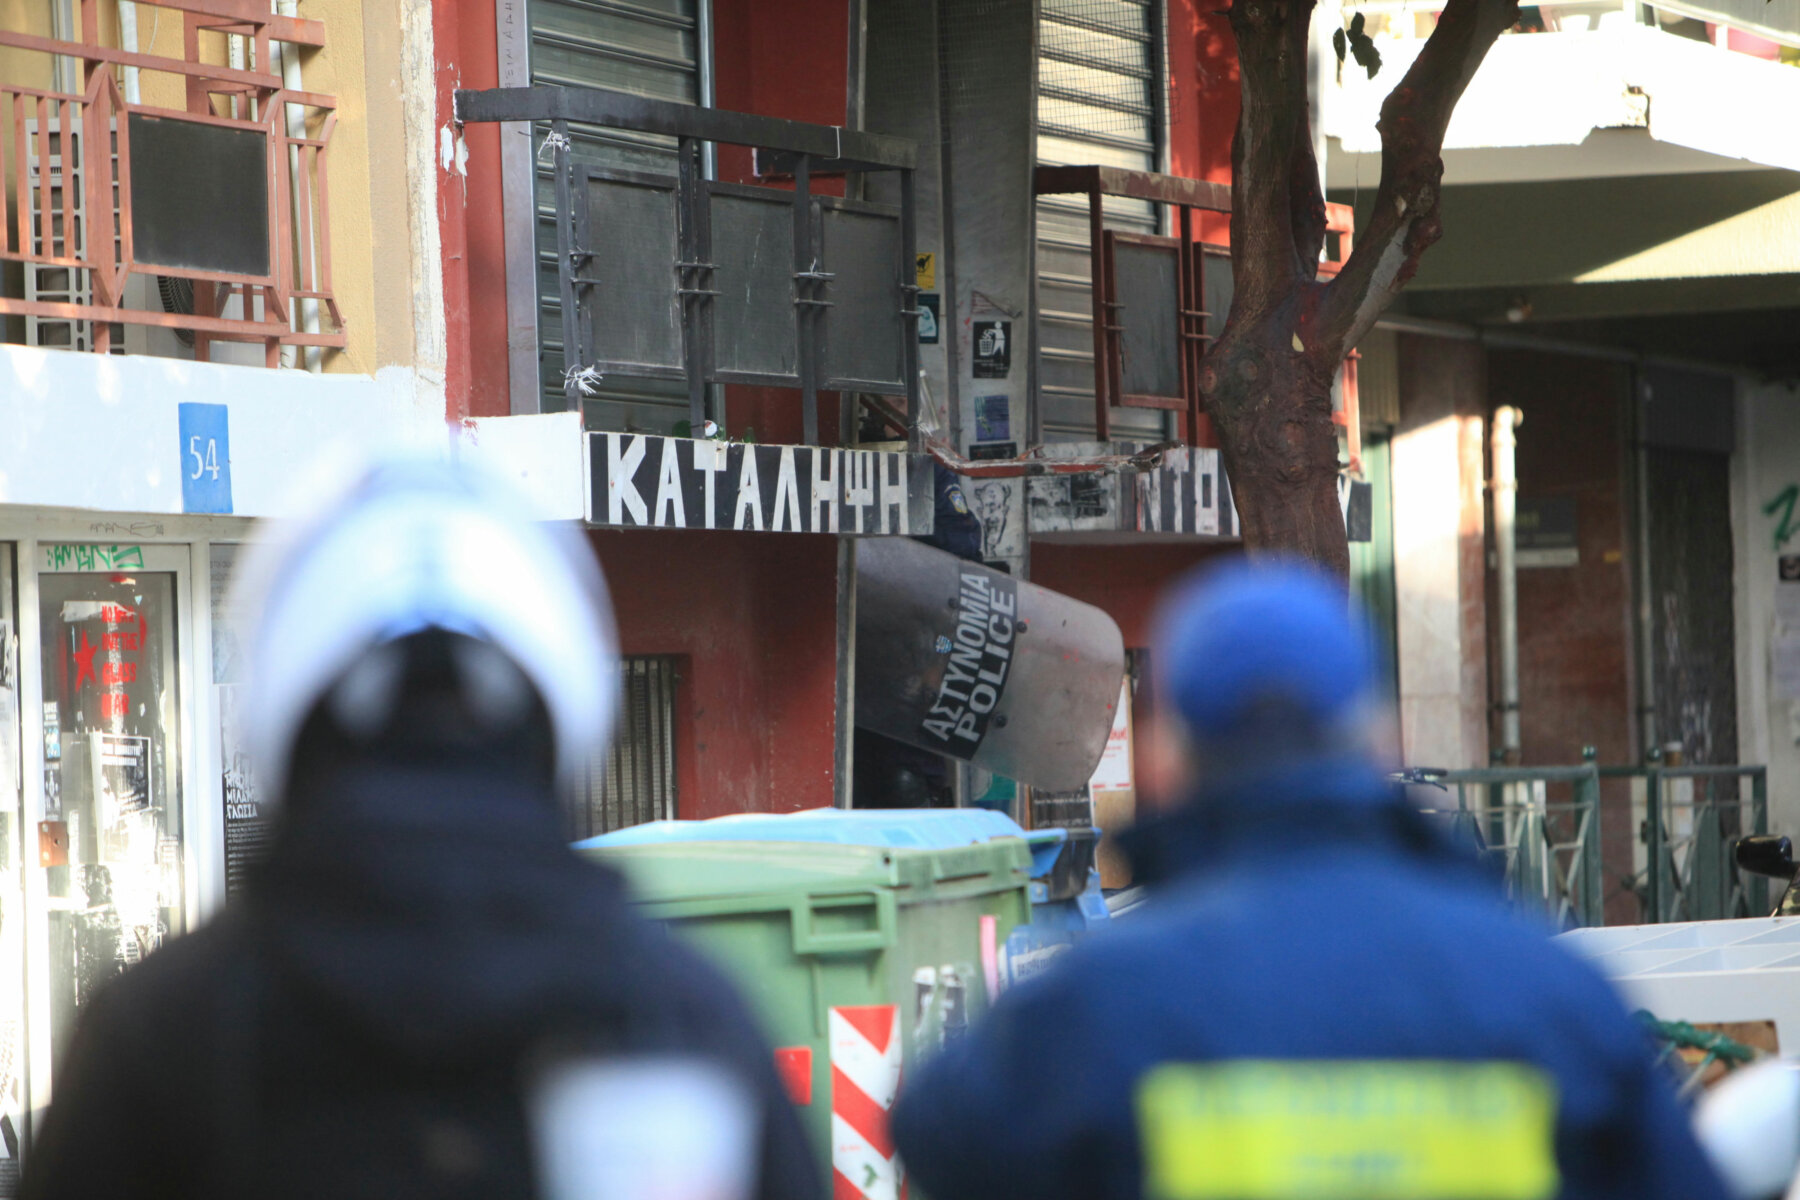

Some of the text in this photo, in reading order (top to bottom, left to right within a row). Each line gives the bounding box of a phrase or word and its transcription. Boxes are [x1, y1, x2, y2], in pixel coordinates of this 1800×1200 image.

[189, 435, 221, 481] 54
[607, 434, 909, 534] ΚΑΤΑΛΗΨΗ
[922, 573, 989, 742] ΑΣΤΥΝΟΜΙΑ
[954, 587, 1014, 743] POLICE
